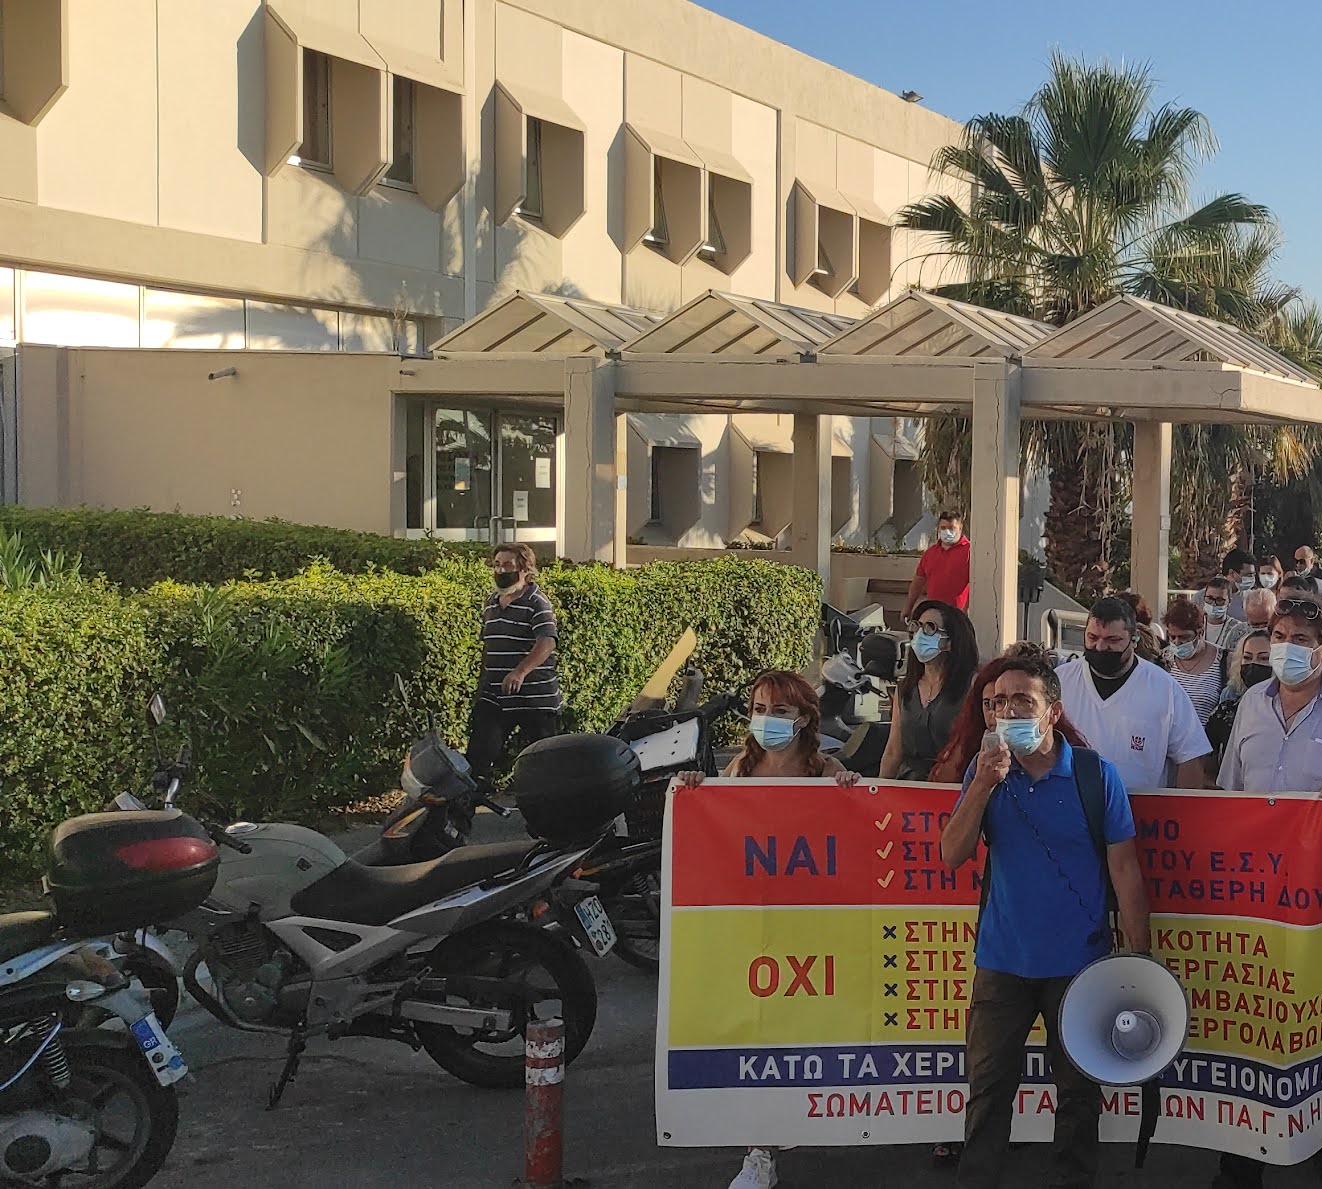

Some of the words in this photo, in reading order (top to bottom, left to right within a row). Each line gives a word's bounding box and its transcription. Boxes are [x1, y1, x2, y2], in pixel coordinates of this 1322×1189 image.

[743, 835, 837, 877] ΝΑΙ
[902, 841, 943, 861] ΣΤ
[1144, 849, 1196, 871] ΤΟΥ
[904, 869, 956, 890] ΣΤΗ
[1150, 878, 1265, 903] ΤΑΘΕΡΗ
[905, 921, 978, 943] ΣΤΗΝ
[747, 955, 836, 998] ΟΧΙ
[905, 950, 968, 972] ΣΤΙΣ
[1165, 957, 1296, 995] ΕΡΓΑΣΙΑΣ
[906, 979, 969, 1001] ΣΤΙΣ
[906, 1008, 970, 1030] ΣΤΗ
[143, 1036, 158, 1049] GR
[738, 1053, 823, 1081] ΚΑΤΩ
[837, 1052, 879, 1079] ΤΑ
[807, 1089, 964, 1118] ΣΩΜΑΤΕΙΟ
